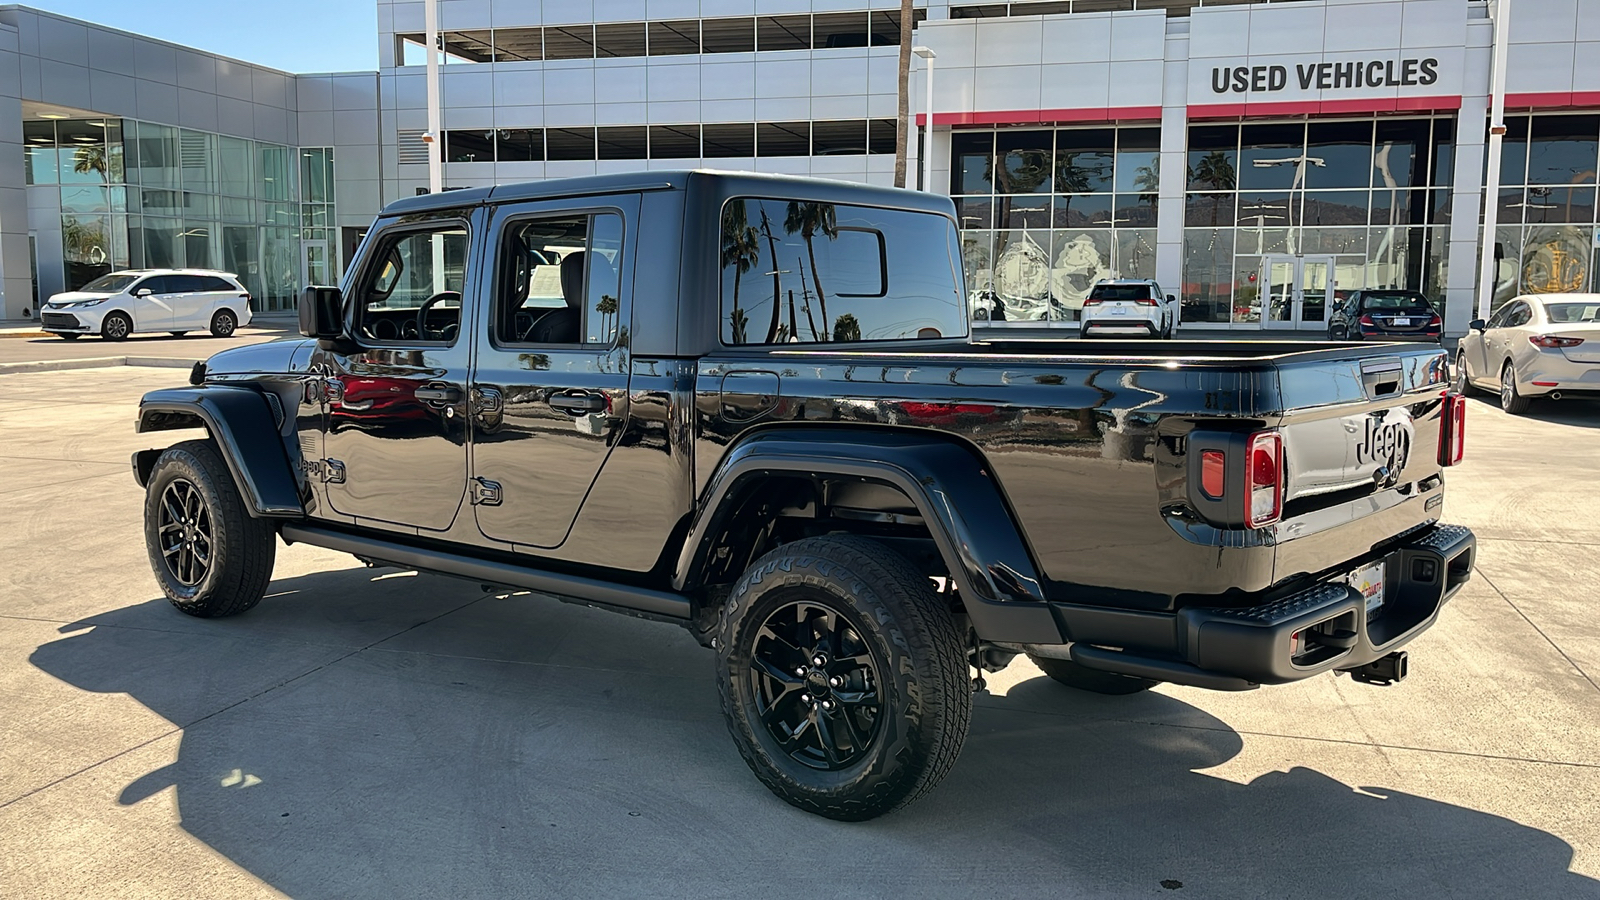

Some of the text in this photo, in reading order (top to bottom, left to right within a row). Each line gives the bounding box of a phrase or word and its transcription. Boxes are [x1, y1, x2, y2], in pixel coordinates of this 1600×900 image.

[1212, 58, 1438, 93] USED VEHICLES
[1357, 418, 1405, 467] Jeep
[297, 456, 320, 475] Jeep
